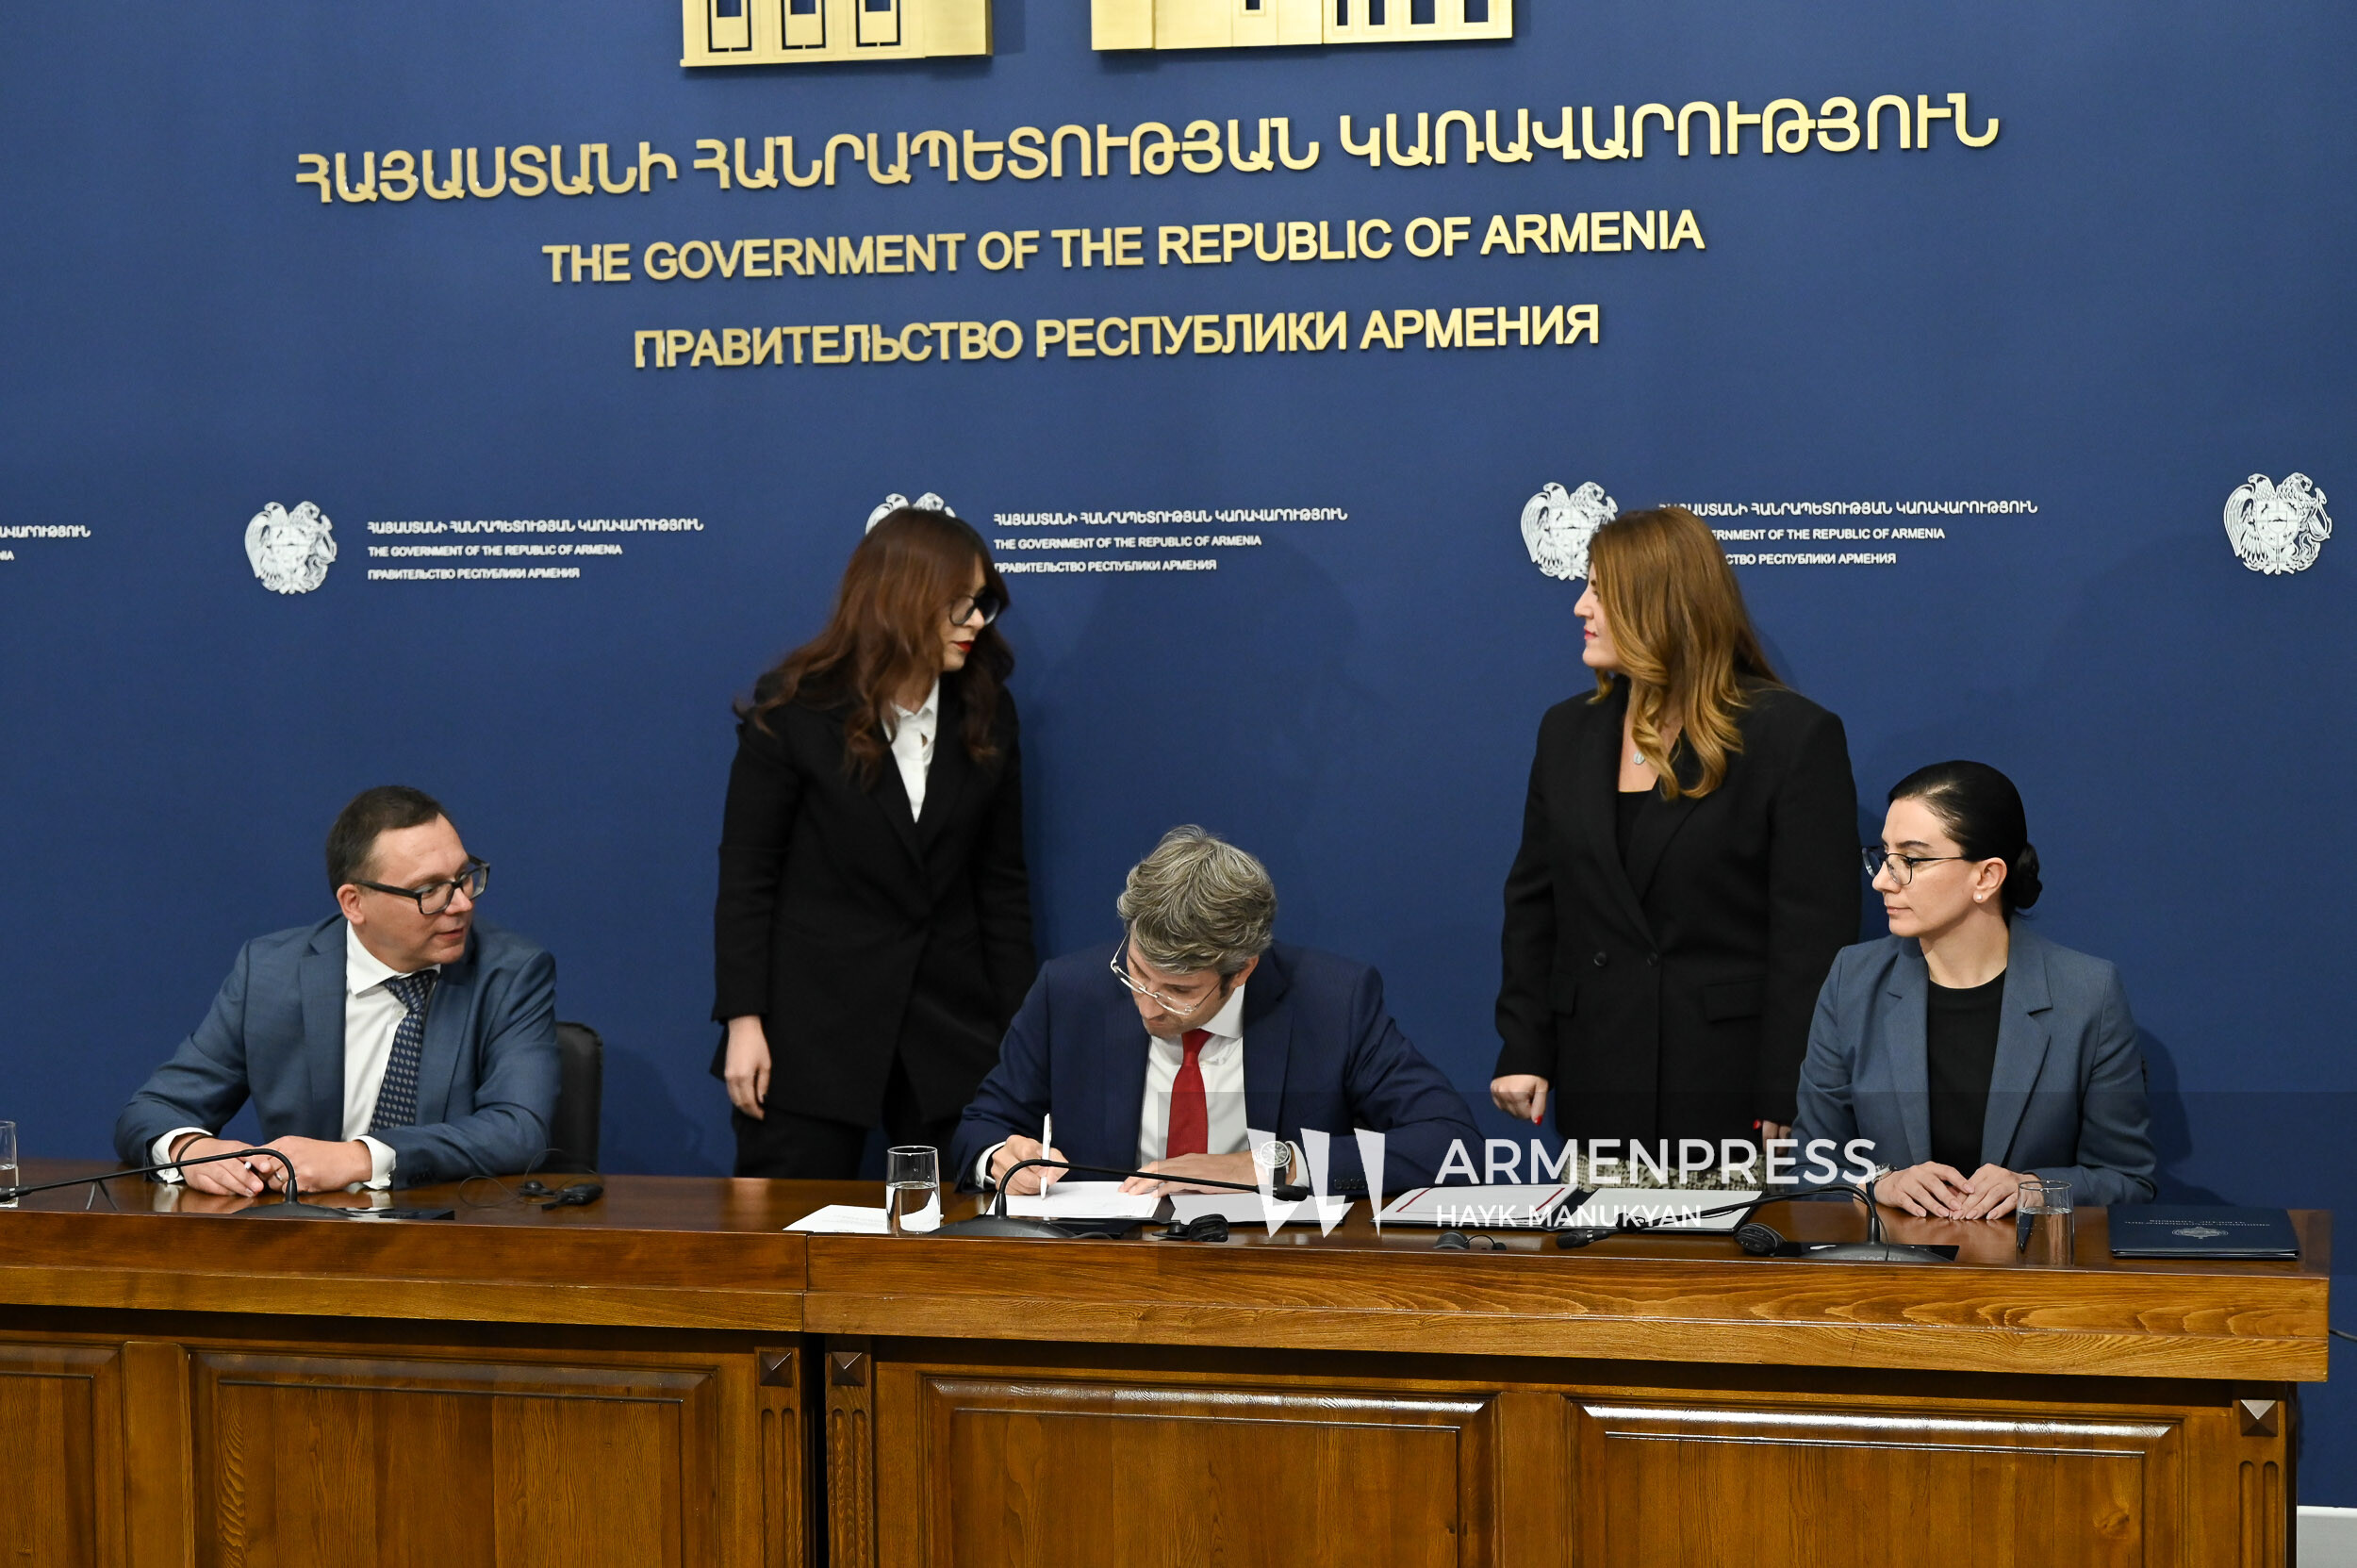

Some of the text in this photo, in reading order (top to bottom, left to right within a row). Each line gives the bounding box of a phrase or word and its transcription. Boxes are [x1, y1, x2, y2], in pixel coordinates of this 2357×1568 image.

[296, 93, 2000, 203] ՀԱՅԱՍՏԱՆԻ ՀԱՆՐԱՊԵՏՈՒԹՅԱՆ ԿԱՌԱՎԱՐՈՒԹՅՈՒՆ
[542, 209, 1705, 282] THE GOVERNMENT OF THE REPUBLIC OF ARMENIA
[635, 305, 1598, 367] ПРАВИТЕЛЬСТВО РЕСПУБЛИКИ АРМЕНИЯ
[1658, 500, 2038, 517] ԱՍՏԱՆԻ ՀԱՆՐԱՊԵՏՈՒԹՅԱՆ ԿԱՌԱՎԱՐՈՒԹՅՈՒՆ
[993, 512, 1079, 526] ՀԱՅԱՍՏԱՆԻ
[0, 524, 91, 538] ԱՎԱՐՈՒԹՅՈՒՆ
[1711, 527, 1946, 540] RNMENT OF THE REPUBLIC OF ARMENIA
[993, 535, 1262, 550] THE GOVERNMENT OF THE REPUBLIC OF ARMENIA
[368, 544, 623, 557] THE GOVERNMENT OF THE REPUBLIC OF ARMENIA
[993, 559, 1217, 573] ПРАВИТЕЛЬСТВО РЕСПУБЛИКИ АРМЕНИЯ
[1758, 553, 1837, 565] РЕСПУБЛИКИ
[1838, 553, 1897, 565] АРМЕНИЯ
[367, 567, 581, 580] ПРАВИТЕЛЬСТВО РЕСПУБЛИКИ АРМЕНИЯ
